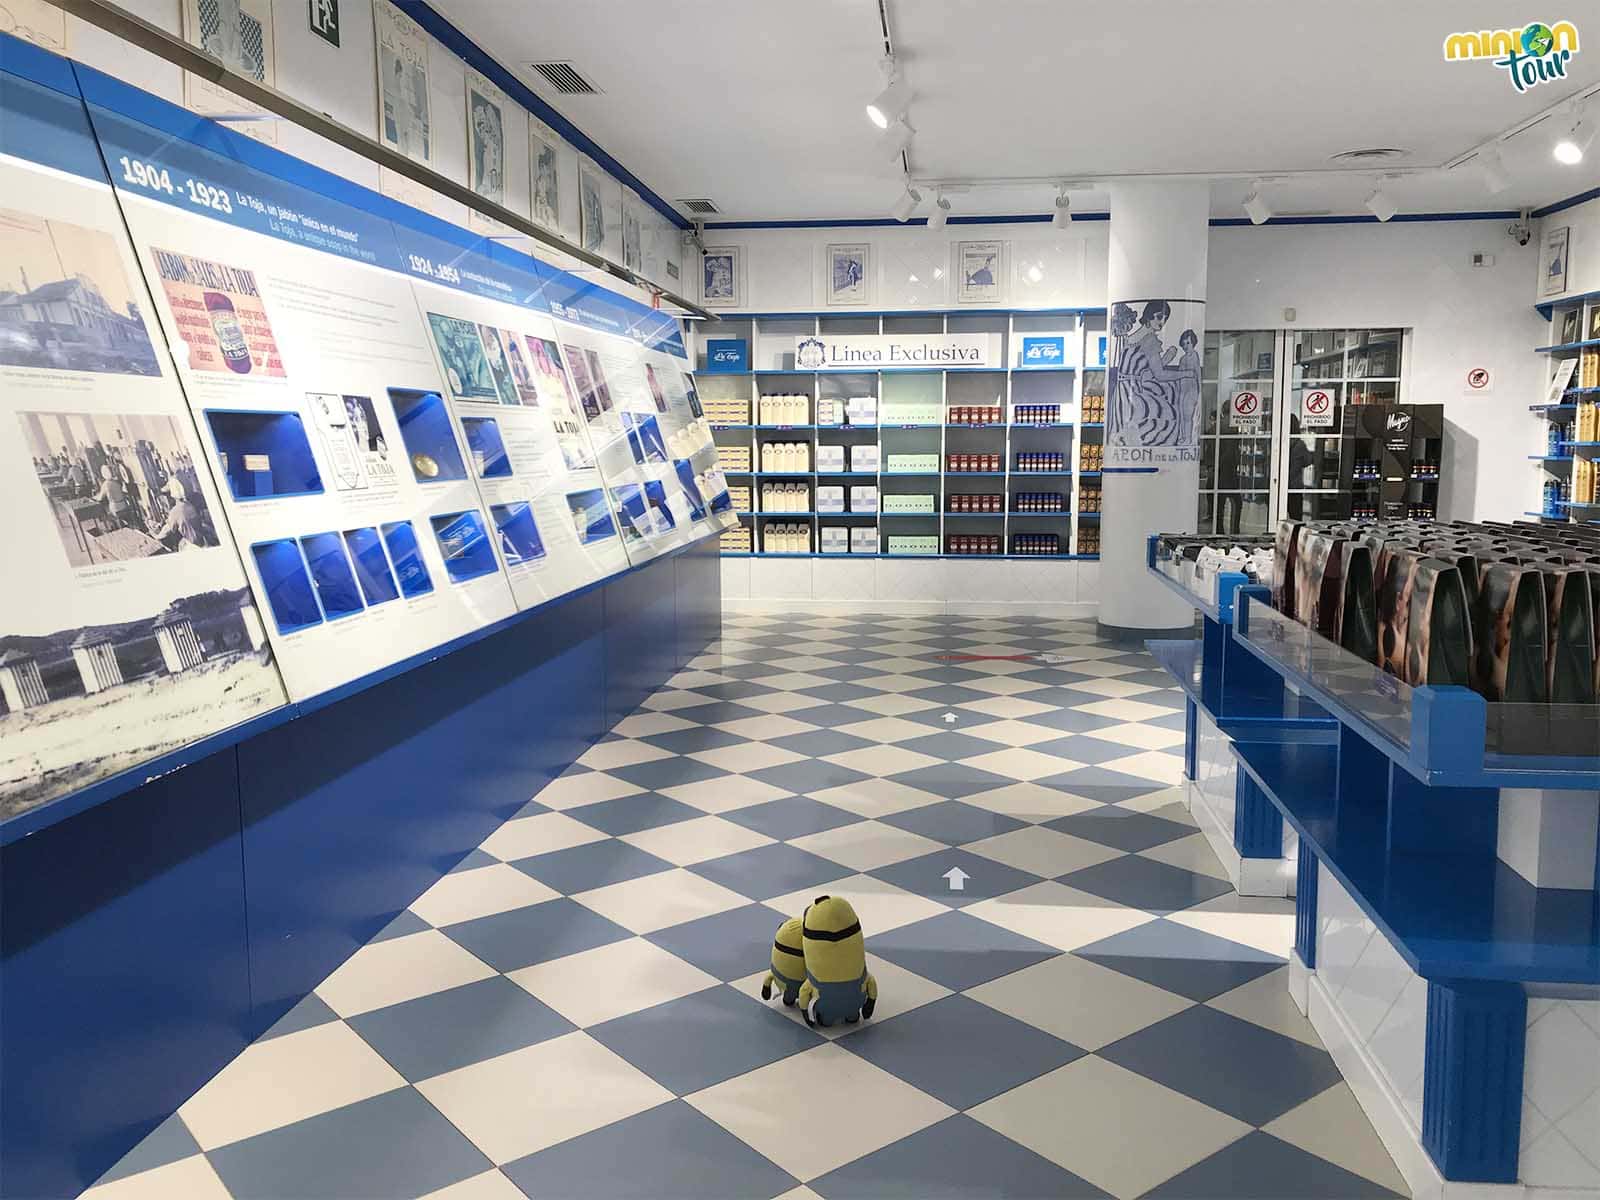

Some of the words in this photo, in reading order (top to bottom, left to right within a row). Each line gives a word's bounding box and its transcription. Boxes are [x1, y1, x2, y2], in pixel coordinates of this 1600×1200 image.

[120, 156, 173, 195] 1904
[186, 179, 233, 214] 1923
[236, 192, 247, 206] La
[247, 195, 267, 214] Toja,
[269, 218, 279, 231] La
[409, 254, 433, 275] 1924
[889, 343, 980, 361] Exclusiva
